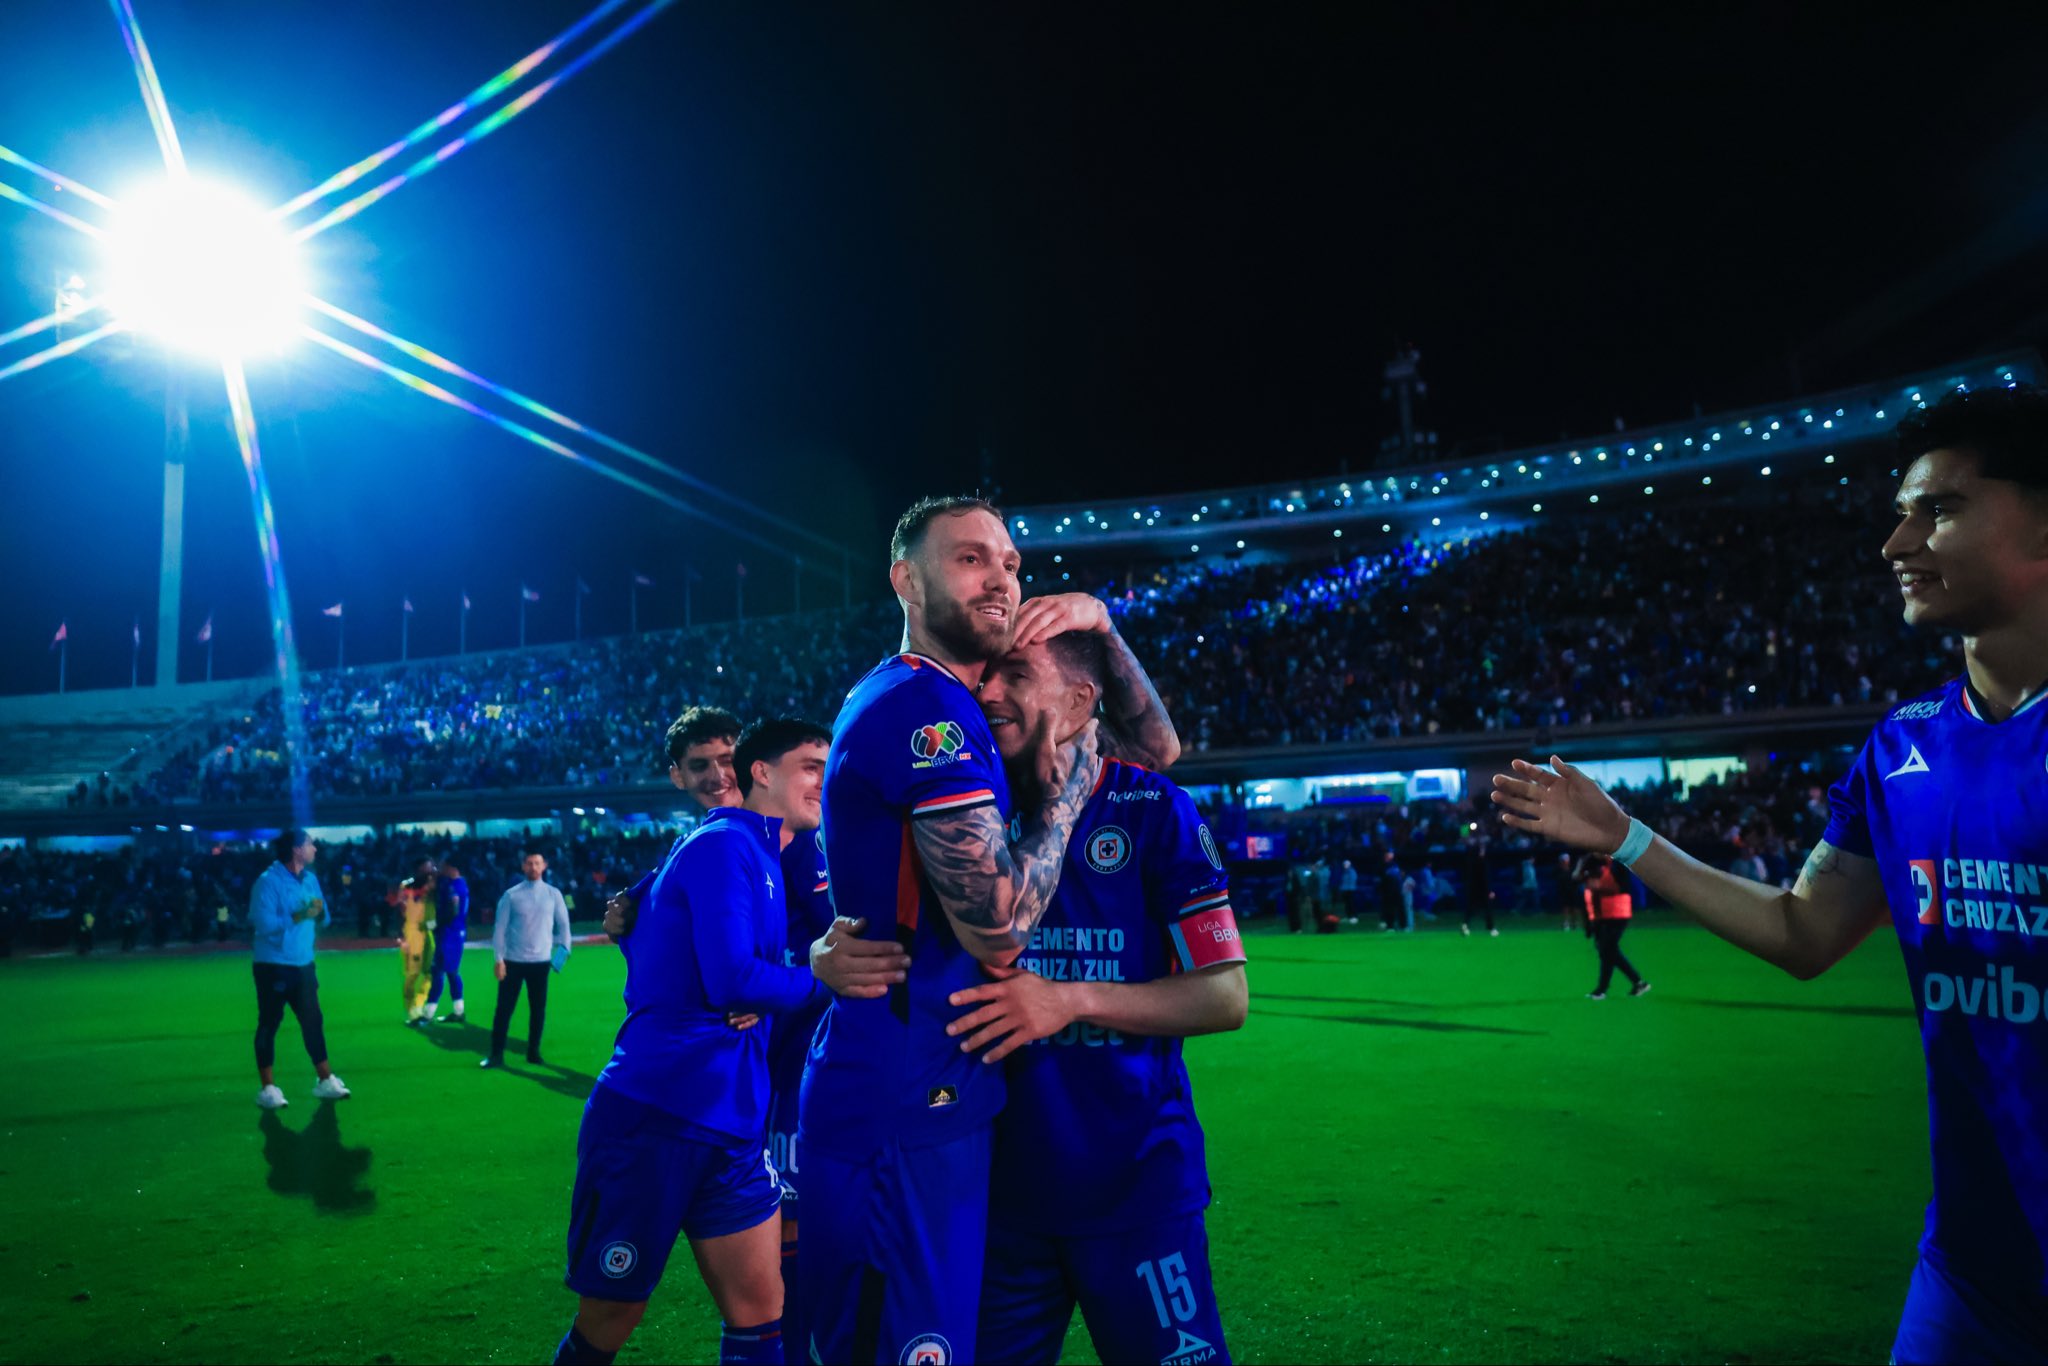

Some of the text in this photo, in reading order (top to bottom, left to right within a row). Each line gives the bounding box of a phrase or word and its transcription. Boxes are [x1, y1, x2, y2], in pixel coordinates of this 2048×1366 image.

[931, 753, 960, 767] BBVA
[1107, 790, 1161, 803] novibet
[1198, 921, 1222, 933] LIGA
[1027, 927, 1125, 952] EMENTO
[1924, 963, 2048, 1023] ovib
[1136, 1251, 1197, 1328] 15
